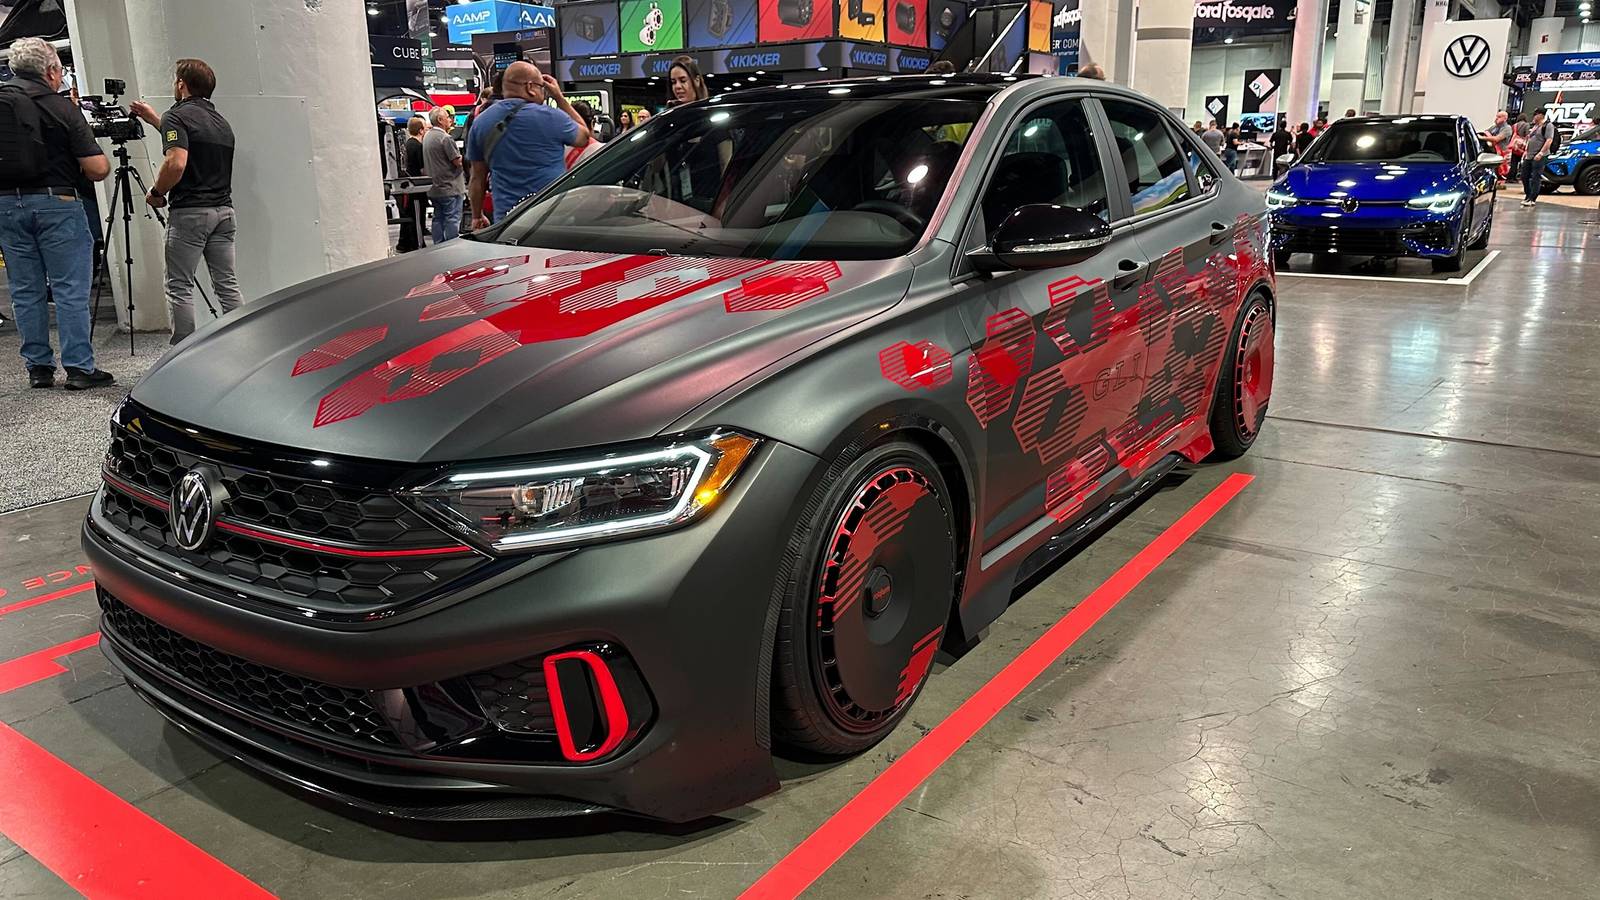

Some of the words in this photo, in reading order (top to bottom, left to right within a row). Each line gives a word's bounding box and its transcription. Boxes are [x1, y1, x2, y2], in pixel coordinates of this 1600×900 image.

[453, 10, 490, 24] AAMP
[392, 46, 420, 60] CUBE
[860, 50, 887, 65] KICKER
[738, 53, 780, 68] KICKER
[586, 63, 621, 75] KICKER
[1543, 102, 1596, 124] MTX
